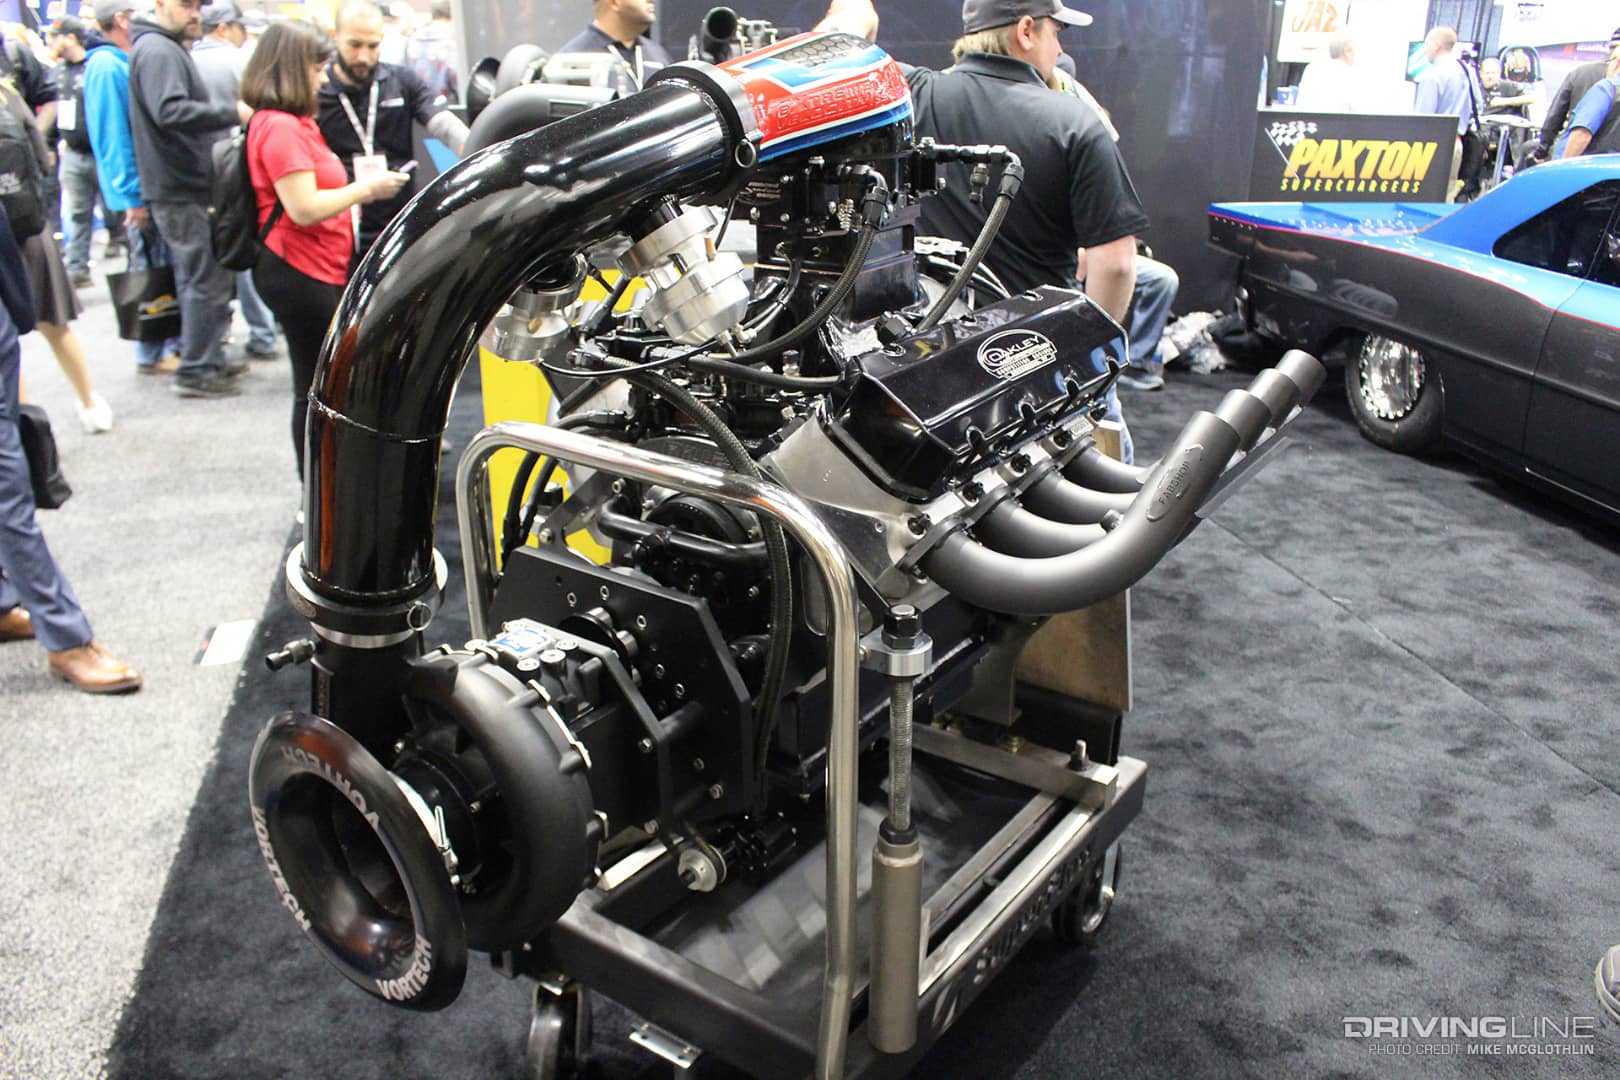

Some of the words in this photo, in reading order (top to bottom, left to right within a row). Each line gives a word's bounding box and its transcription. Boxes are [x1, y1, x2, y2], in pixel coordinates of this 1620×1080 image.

[1284, 138, 1438, 181] PAXTON
[1280, 178, 1421, 193] SUPERCHARGERS
[375, 933, 432, 1001] VORTECH
